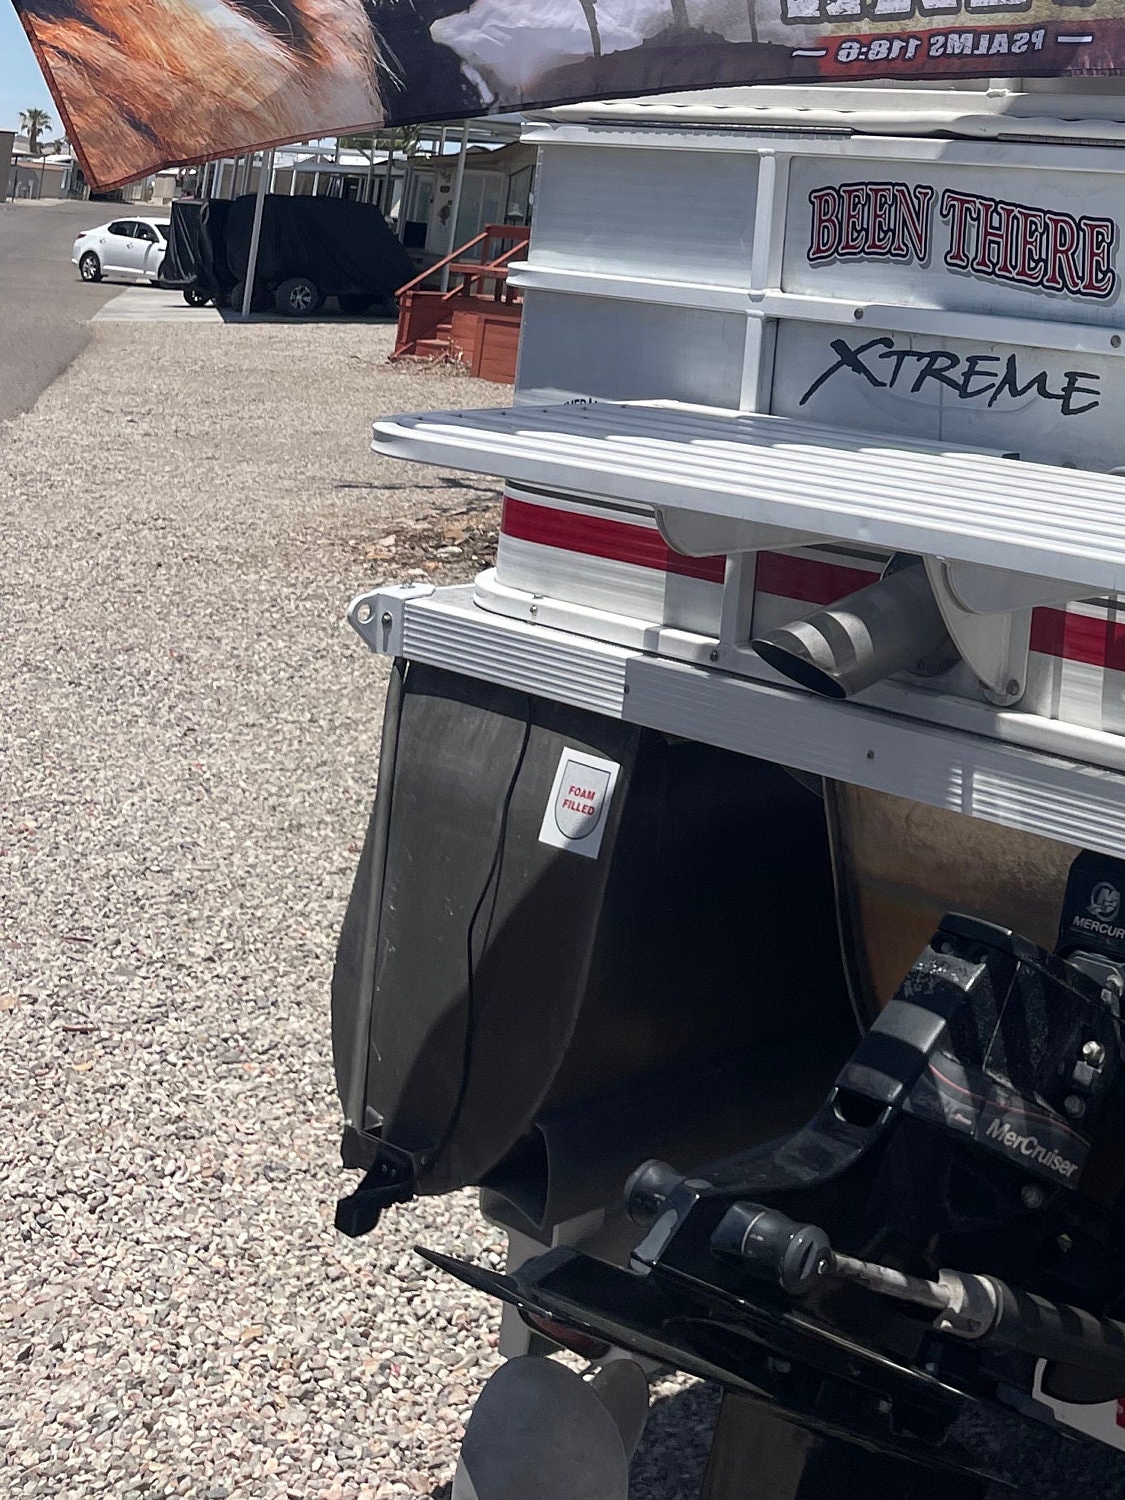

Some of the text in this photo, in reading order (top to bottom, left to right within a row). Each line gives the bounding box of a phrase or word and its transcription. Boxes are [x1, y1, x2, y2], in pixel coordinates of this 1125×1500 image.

[808, 182, 934, 264] BEEN
[940, 189, 1116, 298] THERE
[799, 337, 1101, 415] XTREME
[562, 799, 595, 816] FILLED
[568, 785, 596, 801] FOAM
[985, 1118, 1079, 1178] MerCruiser
